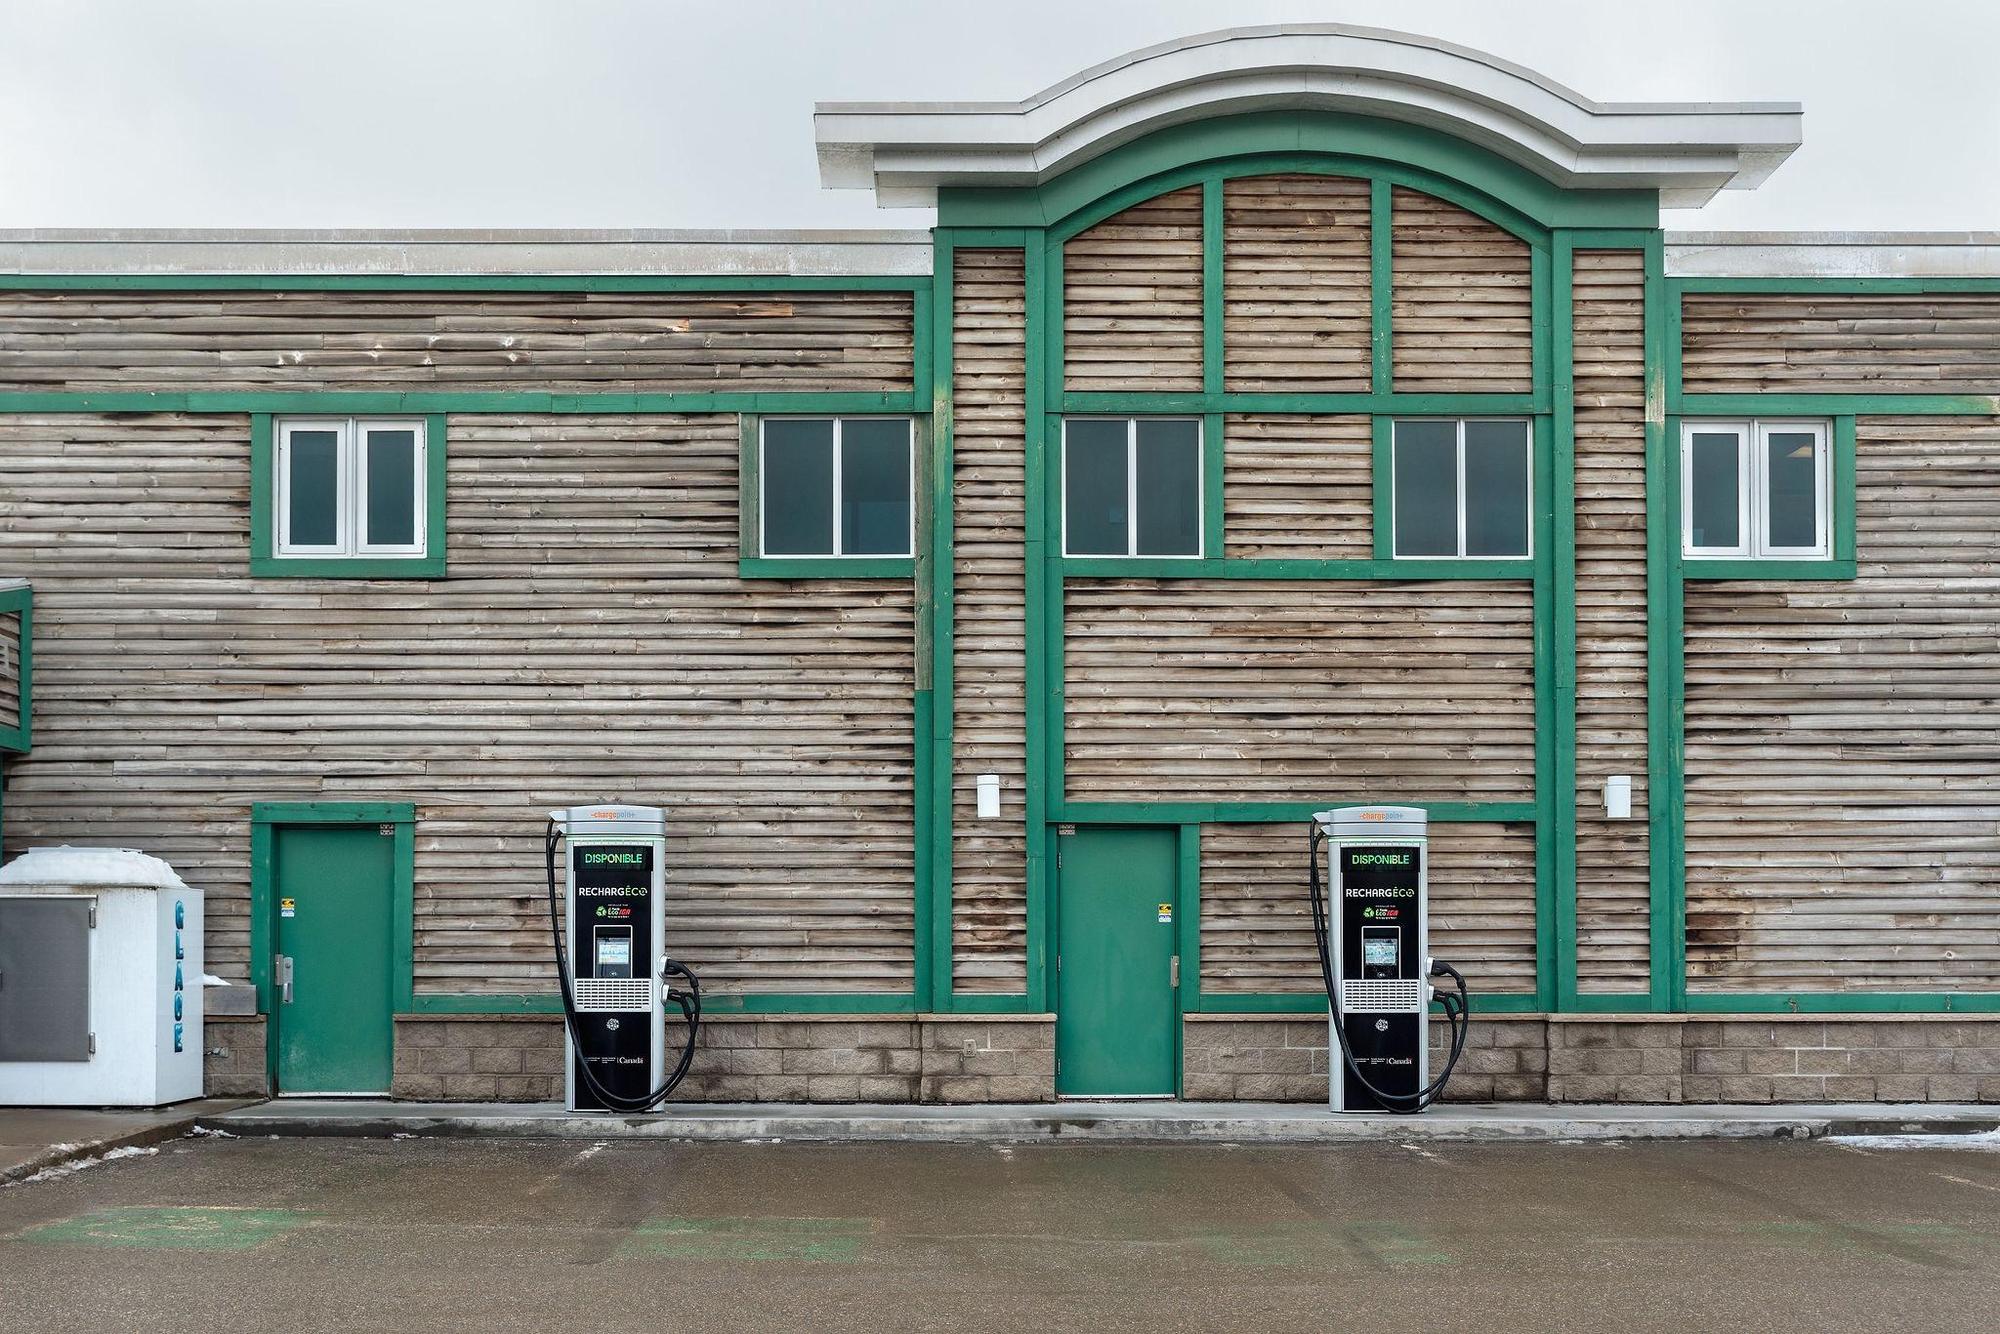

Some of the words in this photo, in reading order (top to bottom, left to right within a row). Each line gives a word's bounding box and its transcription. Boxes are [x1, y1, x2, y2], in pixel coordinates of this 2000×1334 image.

[585, 853, 643, 864] DISPONIBLE
[1352, 854, 1410, 865] DISPONIBLE
[619, 1056, 644, 1064] Canada
[1388, 1057, 1412, 1065] Canada
